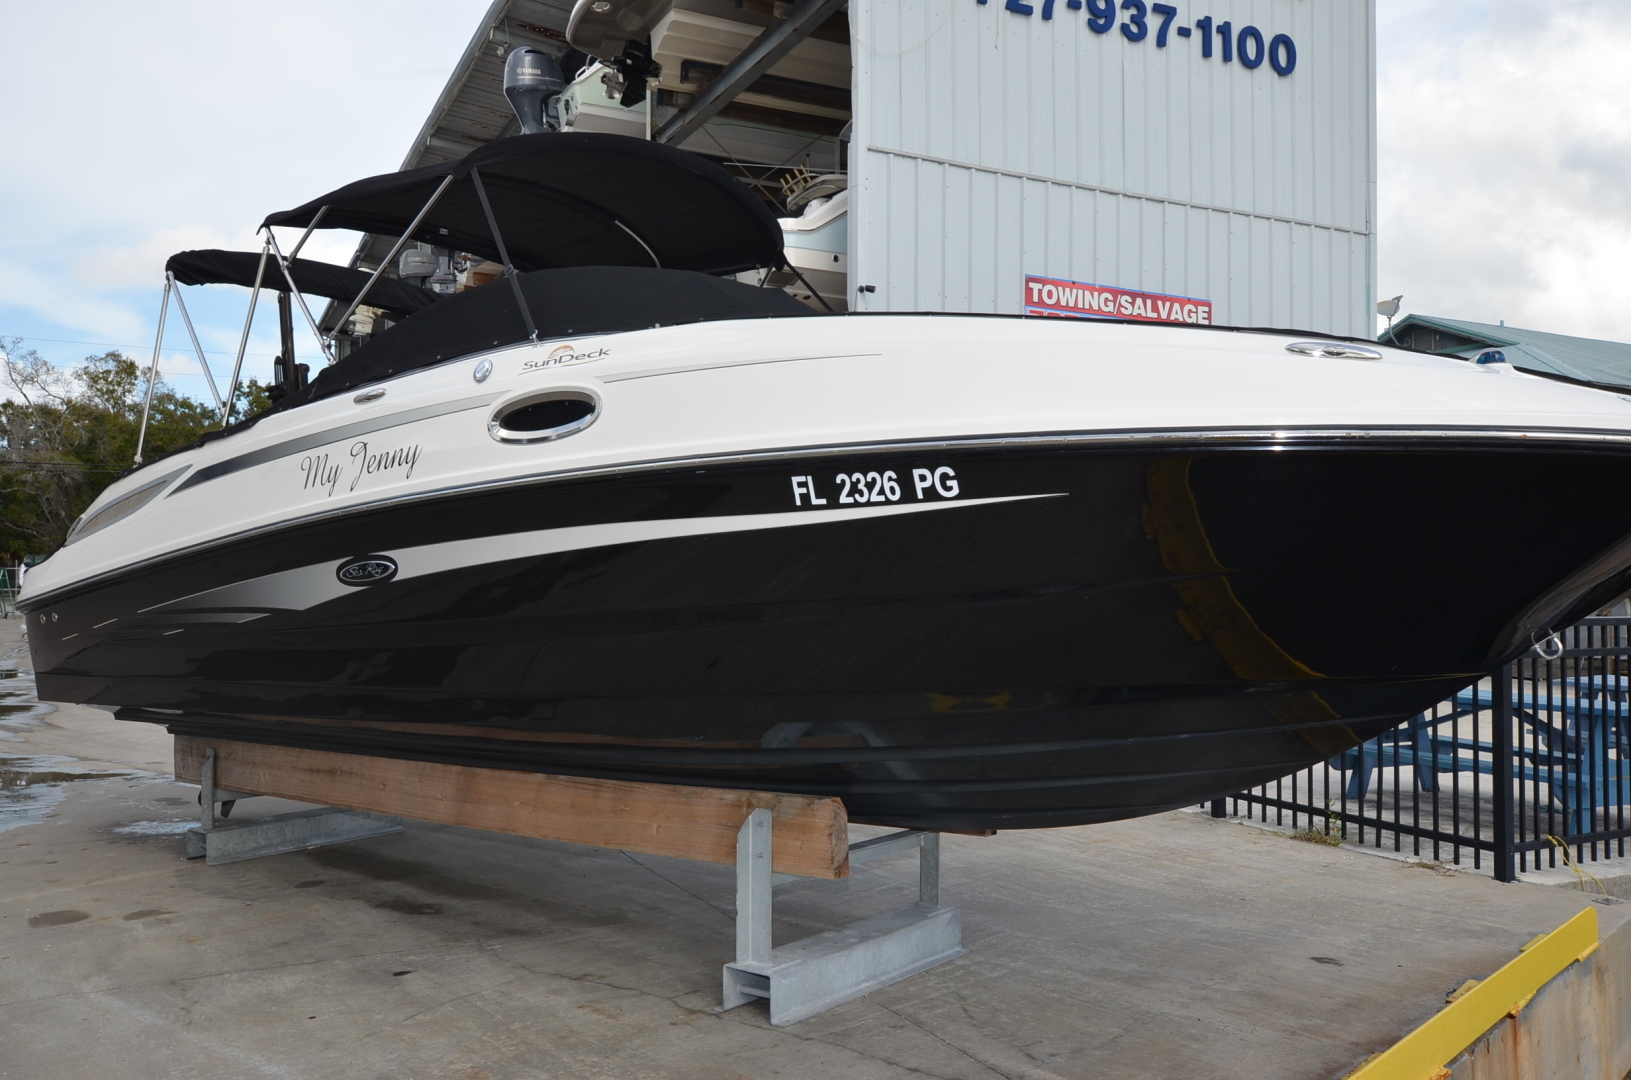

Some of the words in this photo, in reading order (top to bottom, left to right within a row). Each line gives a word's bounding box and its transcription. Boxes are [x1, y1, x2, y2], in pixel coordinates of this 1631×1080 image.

[976, 0, 1297, 76] -937-1100
[1028, 282, 1210, 325] TOWING/SALVAGE
[522, 348, 611, 370] SunDeck
[300, 453, 343, 497] My
[350, 441, 423, 492] Jenny
[791, 475, 828, 506] FL
[835, 470, 901, 504] 2326
[912, 466, 960, 500] PG
